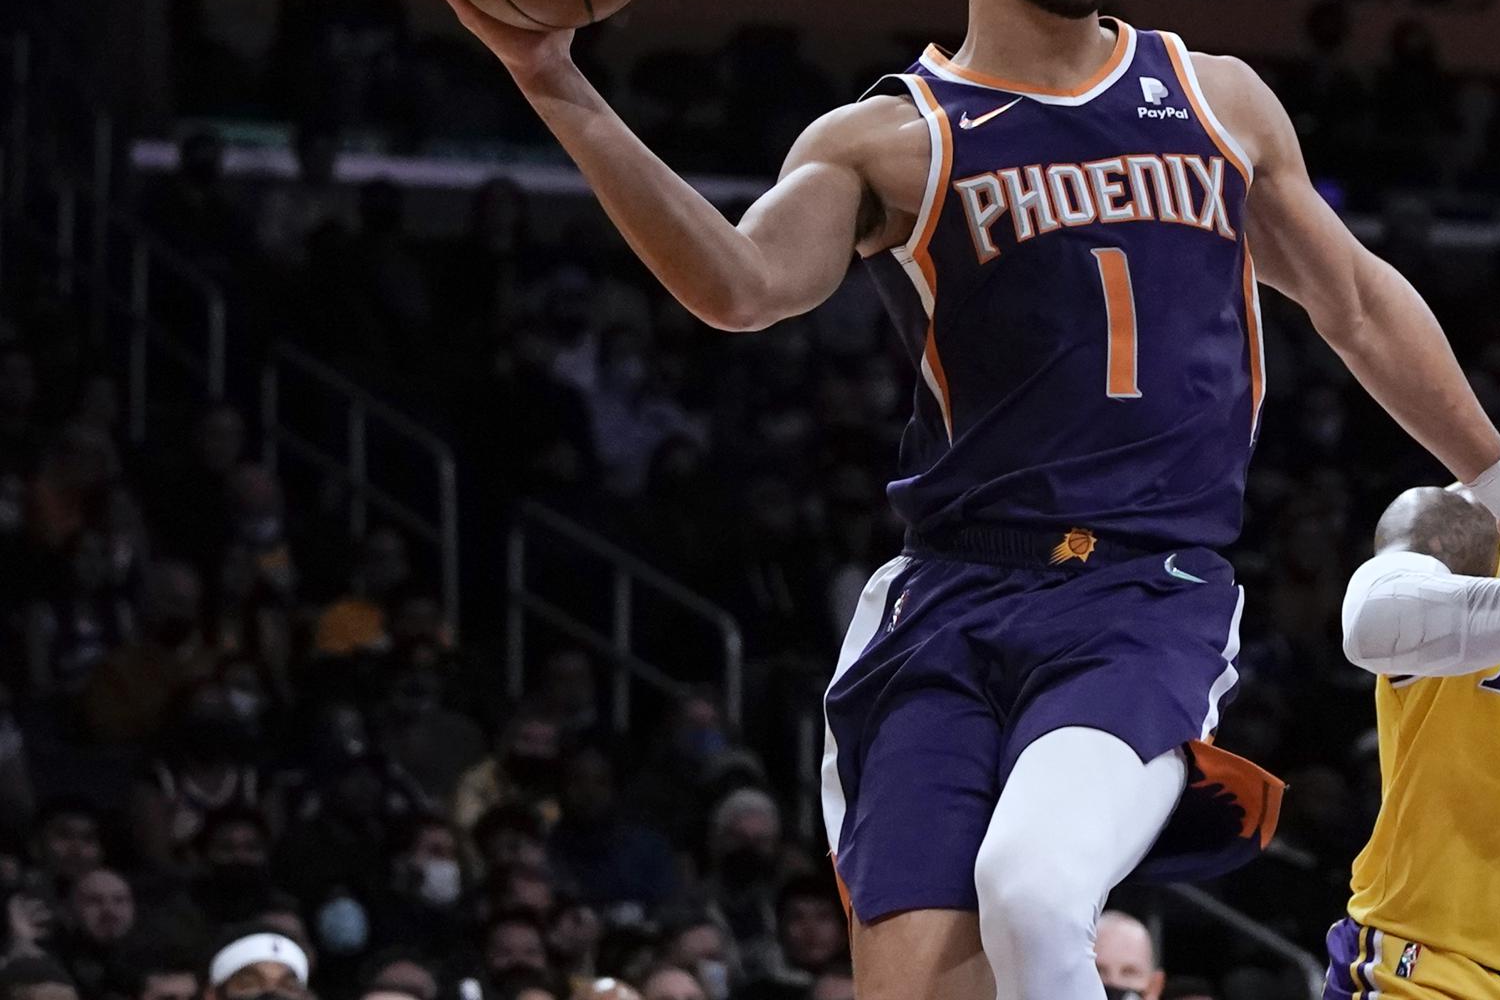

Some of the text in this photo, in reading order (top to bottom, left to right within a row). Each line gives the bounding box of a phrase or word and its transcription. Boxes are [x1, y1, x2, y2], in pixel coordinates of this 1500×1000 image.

[1137, 106, 1189, 120] PayPal
[953, 153, 1237, 265] PHOENIX
[1090, 247, 1143, 398] 1
